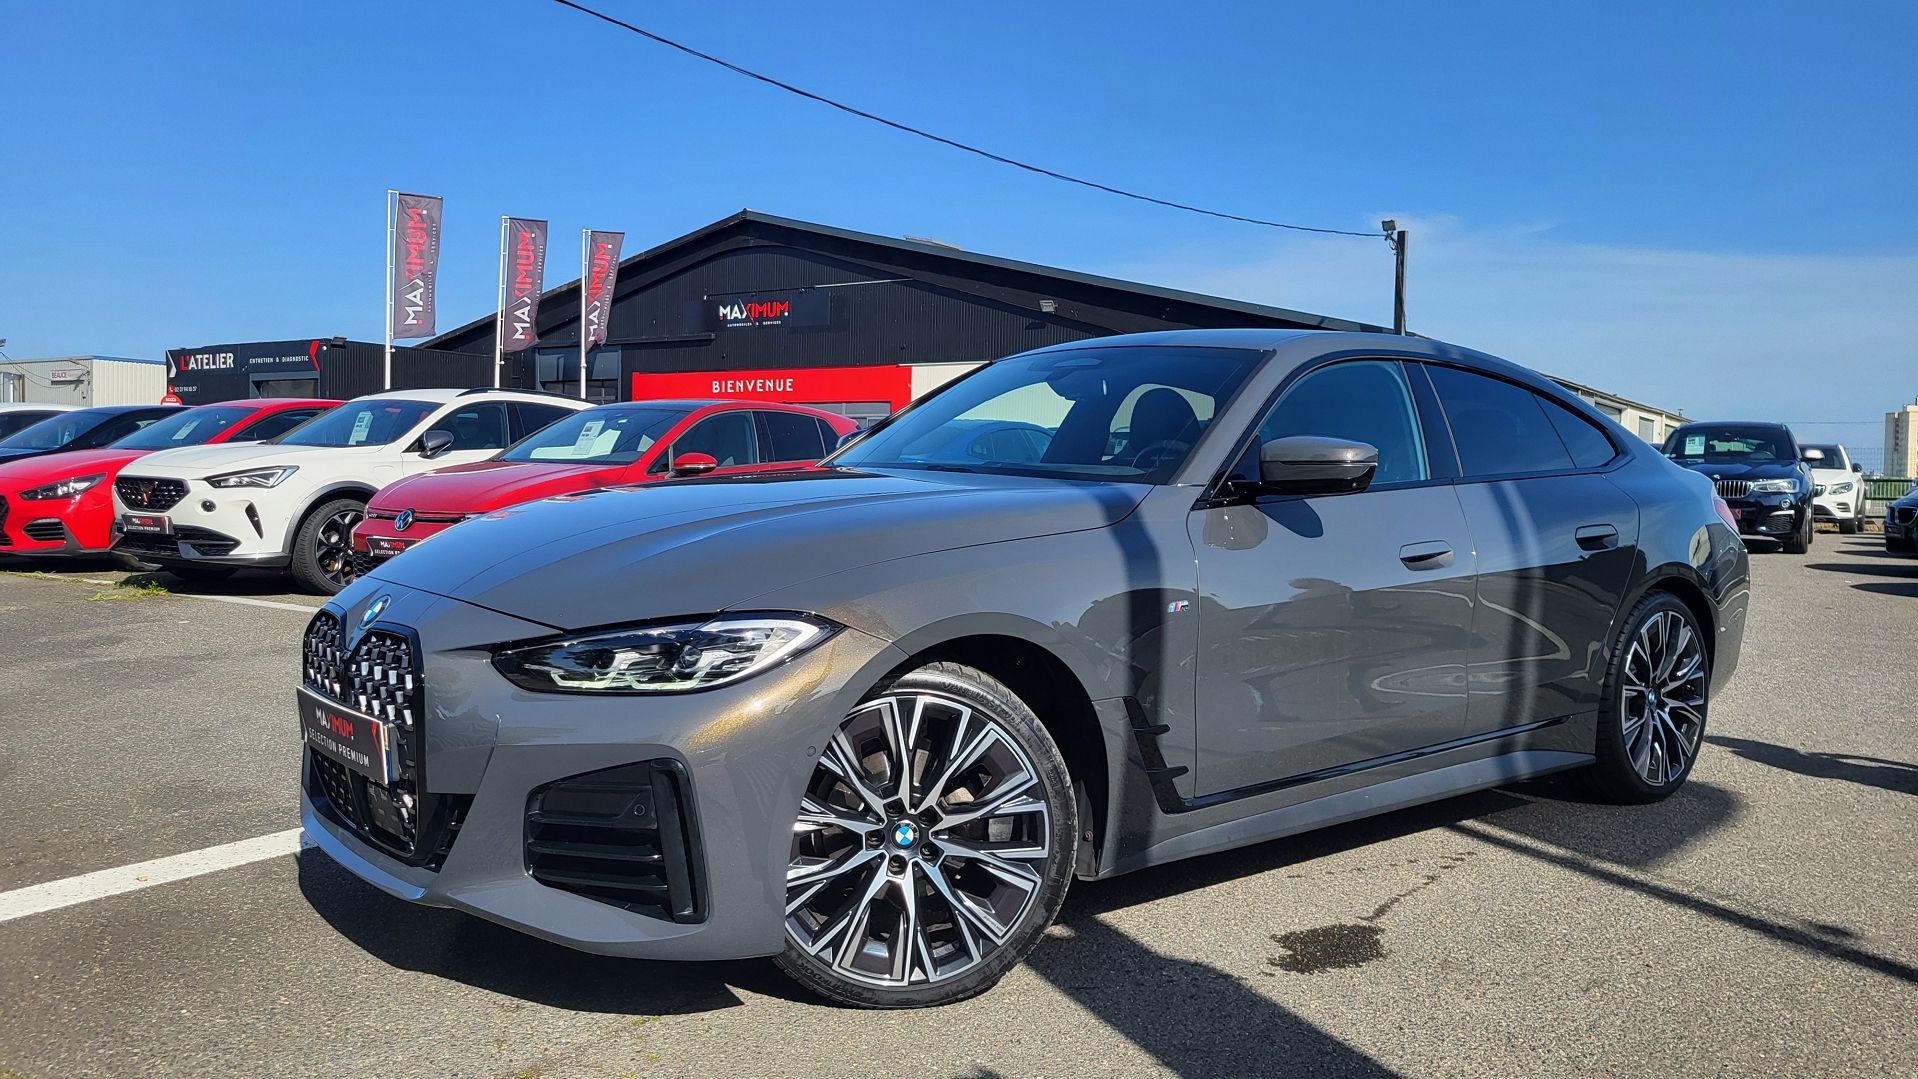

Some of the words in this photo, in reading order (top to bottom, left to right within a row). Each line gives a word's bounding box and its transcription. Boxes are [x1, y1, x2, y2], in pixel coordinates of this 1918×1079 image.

[179, 352, 234, 371] L'ATELIER
[282, 355, 309, 363] DIAGNOSTIC
[712, 378, 794, 393] BIENVENUE
[315, 705, 354, 740] MAXIMUM
[308, 727, 337, 752] SELECTION
[338, 743, 370, 767] PREMIUM
